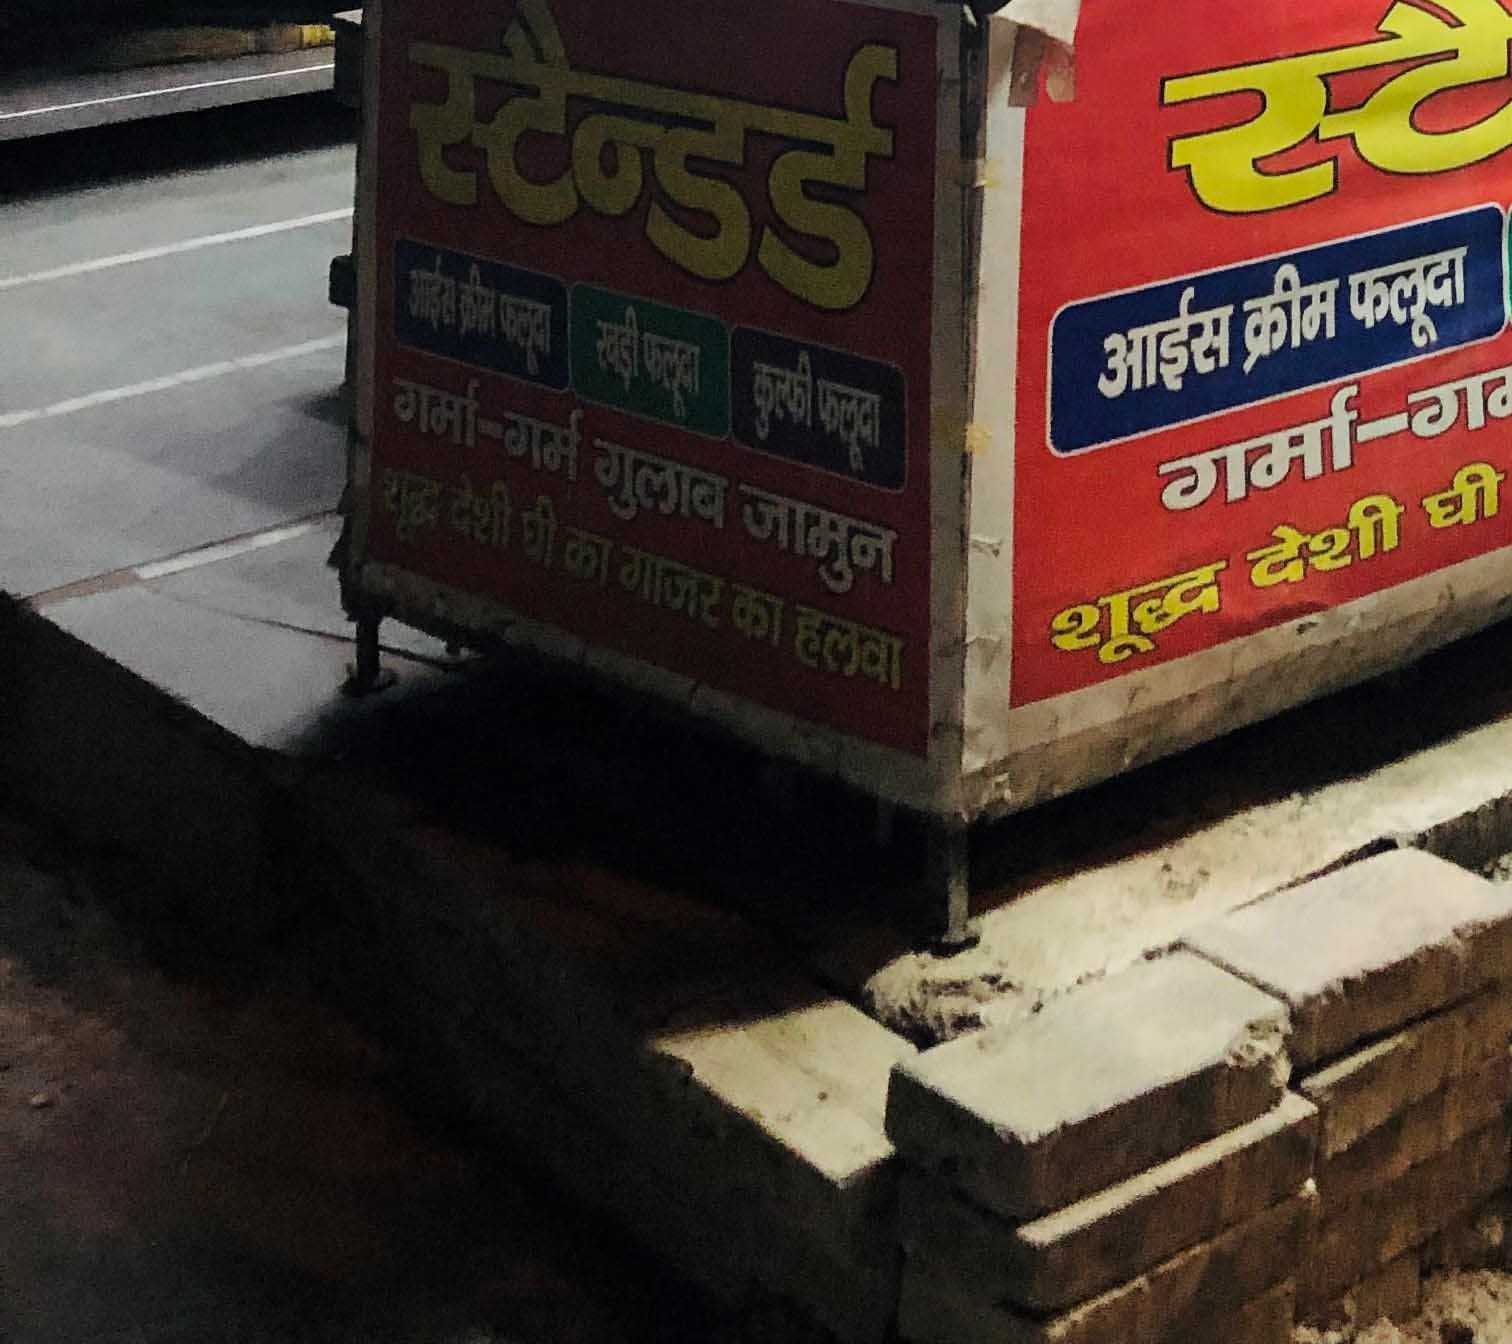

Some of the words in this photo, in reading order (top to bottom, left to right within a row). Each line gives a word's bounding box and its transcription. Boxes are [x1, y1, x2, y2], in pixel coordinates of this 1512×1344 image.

[1242, 263, 1340, 375] क्रीम
[1348, 246, 1469, 348] फलूदा
[738, 482, 899, 593] जामुन
[1246, 494, 1405, 588] देशी
[1423, 461, 1505, 530] घी
